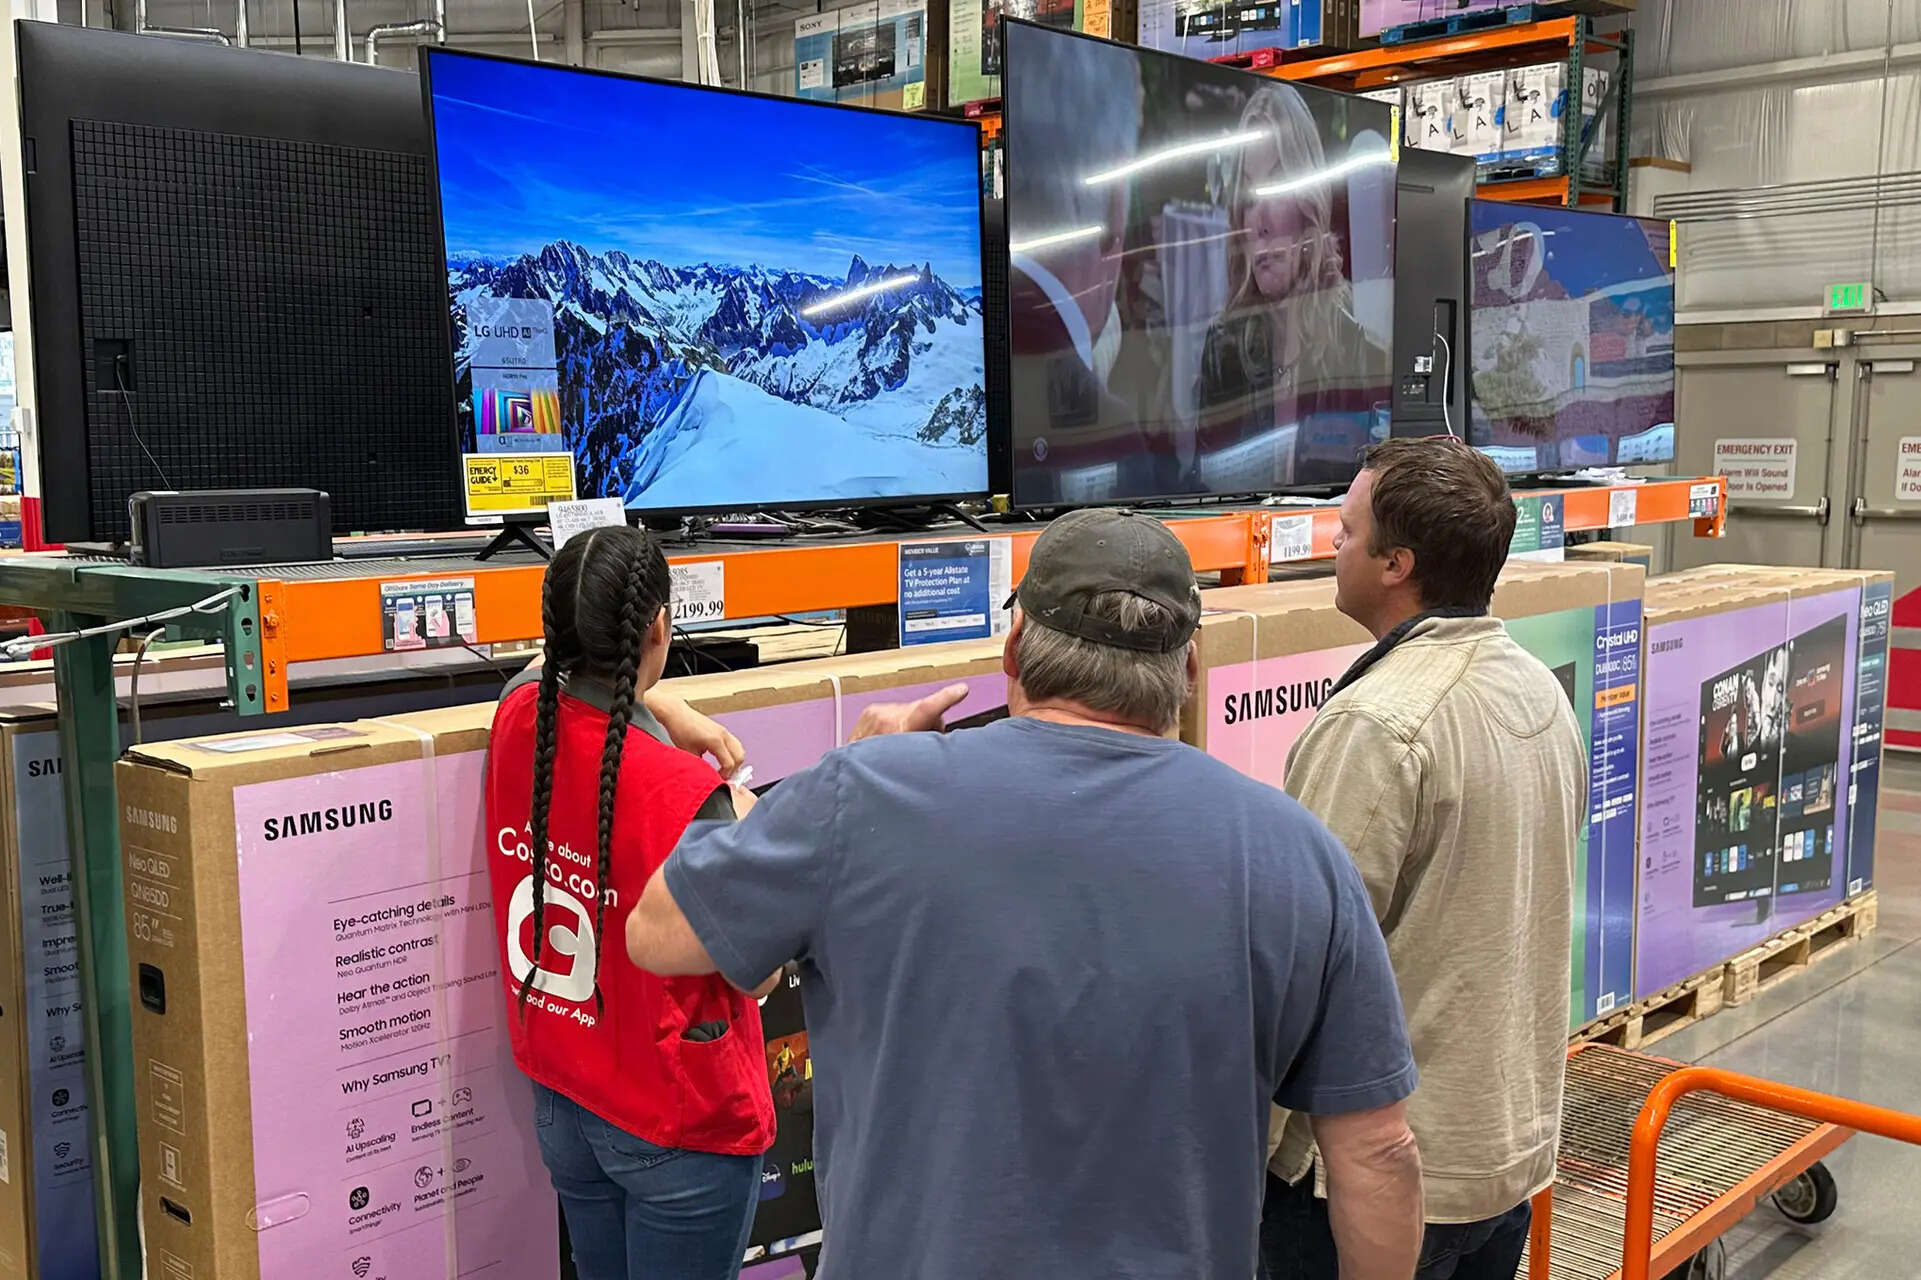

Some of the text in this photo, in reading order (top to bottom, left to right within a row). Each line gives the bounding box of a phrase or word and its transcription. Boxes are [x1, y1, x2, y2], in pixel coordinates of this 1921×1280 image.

[800, 21, 822, 31] SONY
[474, 325, 490, 337] LG
[494, 326, 519, 338] UHD
[1717, 444, 1794, 455] EMERGENCY EXIT
[470, 475, 493, 485] GUIDE
[513, 465, 529, 475] $36
[1718, 469, 1788, 478] Alarm Will Sound
[1745, 482, 1753, 491] Is
[1755, 482, 1788, 493] Opened
[904, 568, 916, 578] Get
[923, 567, 943, 577] 5-year
[944, 566, 968, 575] Allstate
[904, 579, 914, 588] TV
[914, 577, 948, 587] Protection
[949, 576, 962, 584] Plan
[913, 587, 946, 598] additional
[946, 587, 960, 595] cost
[673, 600, 724, 619] 2199.99
[1596, 629, 1638, 649] Crystal UHD
[1651, 637, 1683, 654] SAMSUNG
[1224, 677, 1333, 725] SAMSUNG
[126, 805, 177, 834] SAMSUNG
[264, 799, 392, 841] SAMSUNG
[129, 852, 170, 878] Neo QLED
[558, 842, 591, 868] about
[498, 827, 618, 908] Coco.com
[333, 895, 456, 932] Eye-catching details
[335, 928, 373, 942] Quantum
[373, 923, 397, 934] Matrix
[444, 907, 460, 917] with
[460, 905, 475, 914] Mini
[335, 935, 439, 967] Realistic contrast
[337, 956, 407, 979] Neo Quantum HDR
[337, 973, 430, 1004] Hear the action
[339, 1005, 360, 1015] Dolby
[392, 993, 406, 1002] and
[407, 986, 431, 999] Object
[463, 974, 485, 985] Sound
[46, 1006, 71, 1017] Why
[547, 1003, 569, 1016] our
[570, 1008, 596, 1028] App
[339, 1008, 431, 1040] Smooth motion
[341, 1022, 431, 1051] Motion Xcelerator 120Hz
[342, 1054, 451, 1094] Why Samsung TV?
[411, 1108, 474, 1133] Endless Content
[346, 1133, 396, 1154] AI Upscaling
[791, 1158, 812, 1175] hulu
[414, 1189, 439, 1203] Planet
[458, 1174, 484, 1188] People
[349, 1202, 402, 1225] Connectivity
